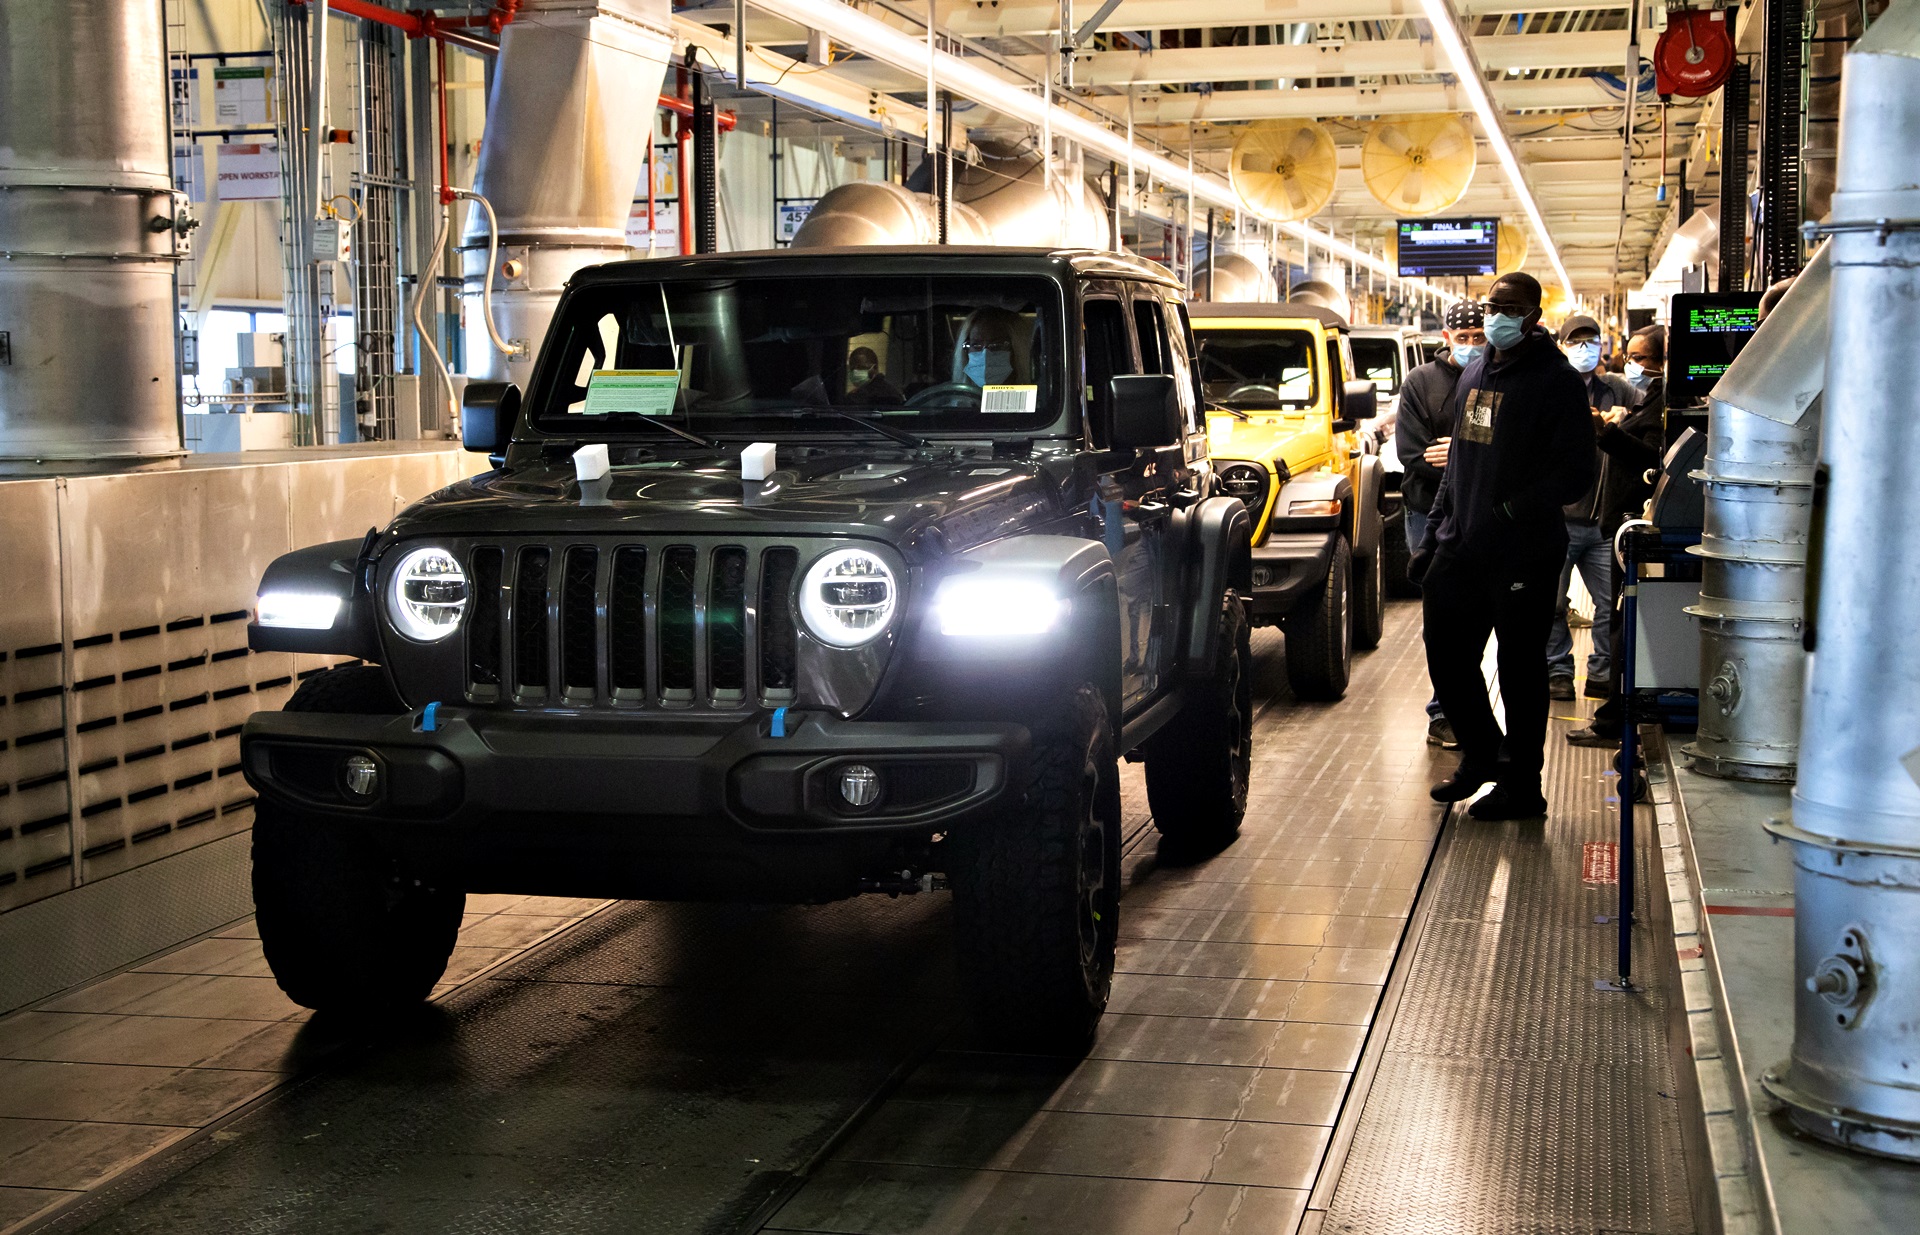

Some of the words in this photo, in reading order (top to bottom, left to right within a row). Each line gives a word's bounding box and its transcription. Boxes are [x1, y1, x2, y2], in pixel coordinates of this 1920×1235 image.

[1433, 223, 1454, 231] FINAL
[1455, 222, 1460, 230] 4
[1476, 405, 1487, 414] THE
[1466, 410, 1485, 420] NOTH
[1468, 417, 1484, 425] FACE
